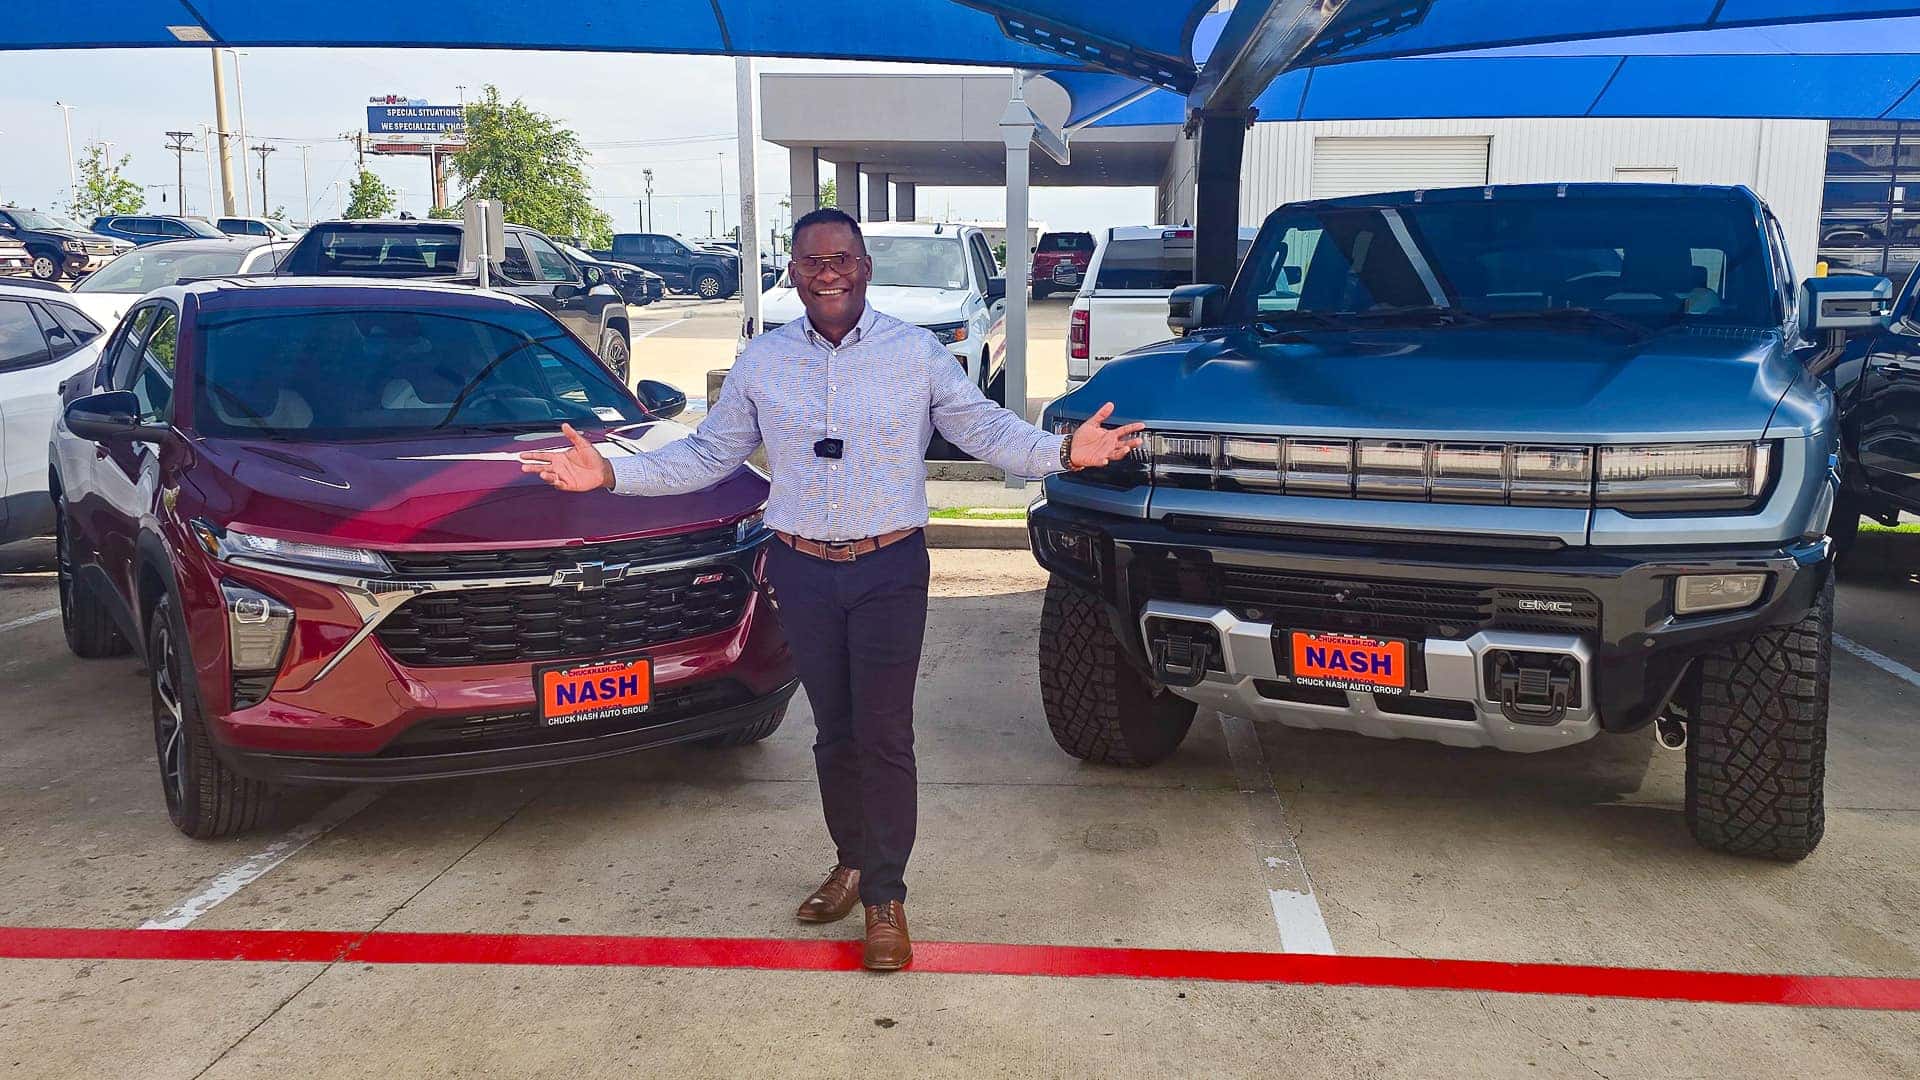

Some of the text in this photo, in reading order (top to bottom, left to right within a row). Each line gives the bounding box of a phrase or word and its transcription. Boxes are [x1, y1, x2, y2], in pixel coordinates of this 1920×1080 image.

[386, 108, 417, 117] SPECIAL
[381, 122, 394, 130] WE
[395, 122, 436, 131] SPECIALIZE
[1518, 599, 1573, 613] GMC
[1305, 646, 1392, 676] NASH
[556, 674, 638, 706] NASH
[1296, 677, 1403, 696] CHUCK NASH AUTO GROUP
[548, 705, 649, 726] CHUCK NASH AUTO GROUP
